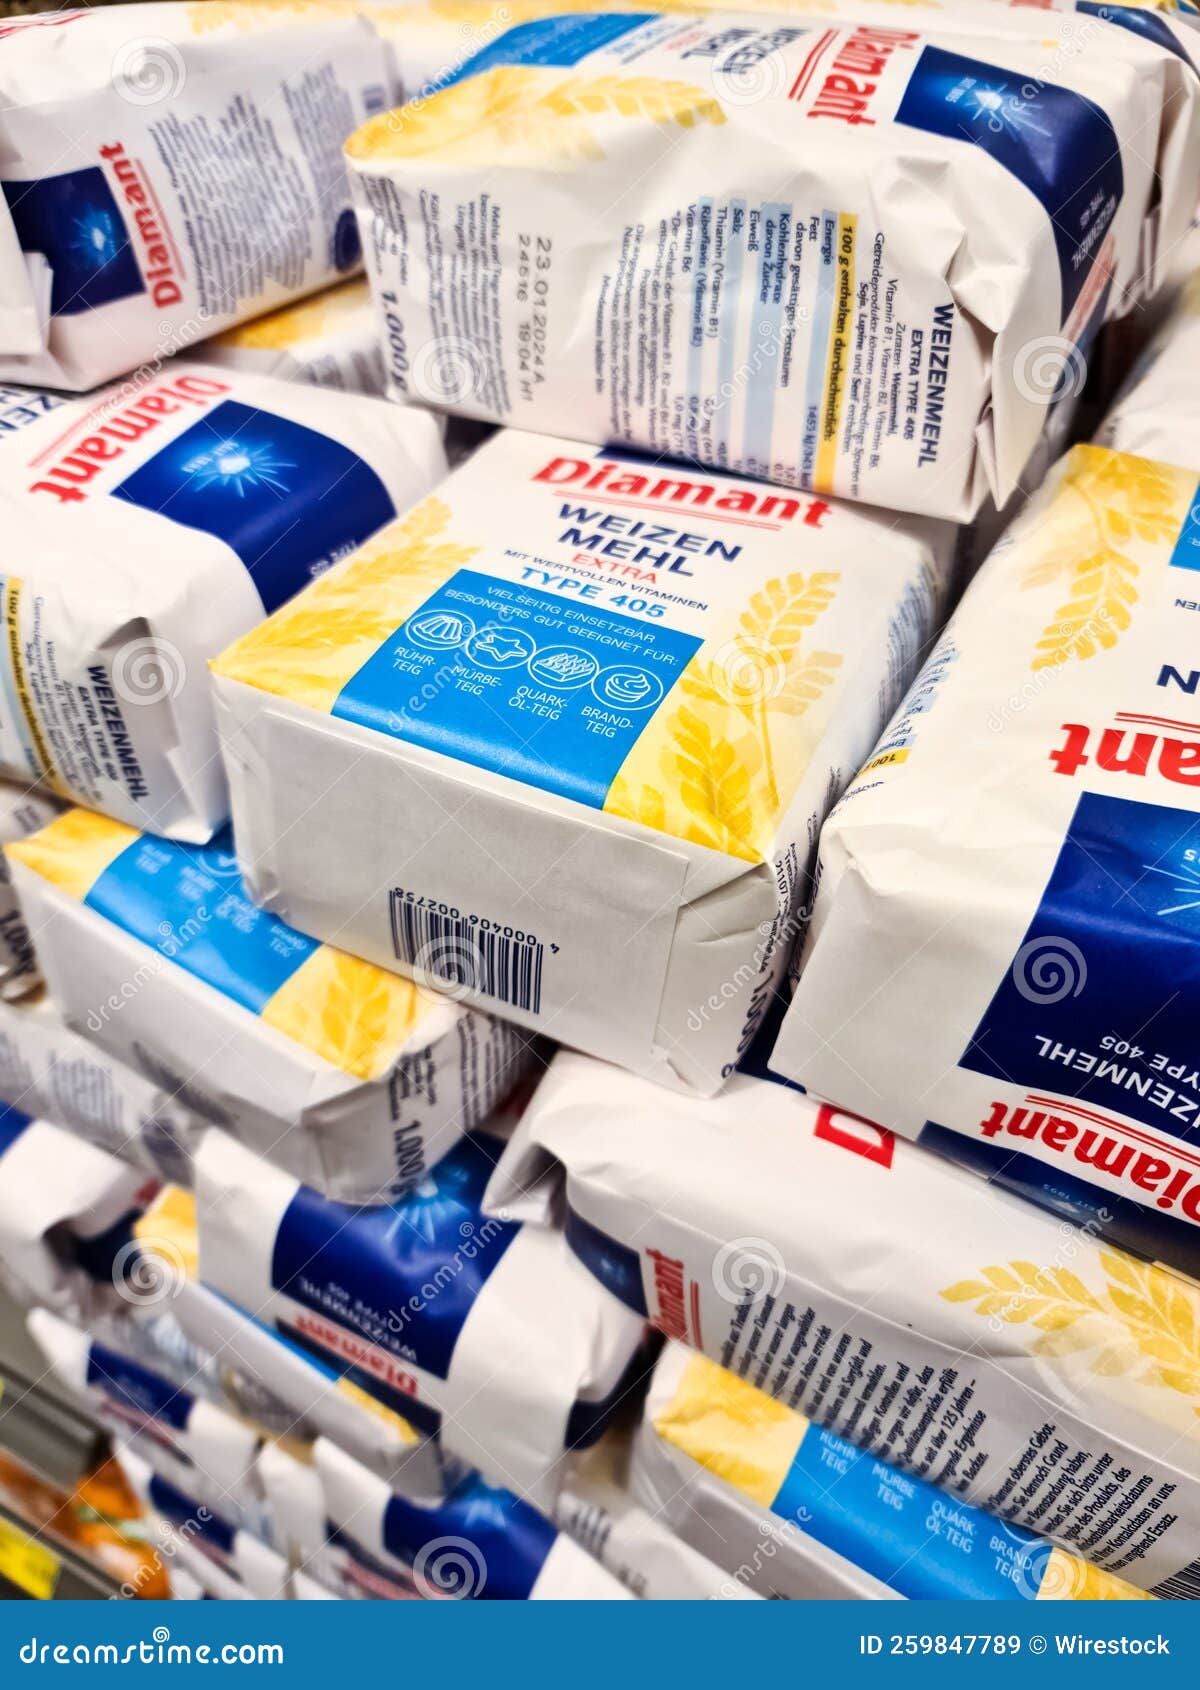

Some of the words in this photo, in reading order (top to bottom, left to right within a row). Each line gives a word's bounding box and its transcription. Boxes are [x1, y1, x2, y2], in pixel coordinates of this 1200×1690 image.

[99, 142, 182, 310] Diamant
[684, 204, 696, 252] Vitamin
[696, 204, 709, 268] Riboflavin
[713, 205, 725, 258] Thiamin
[732, 207, 743, 235] Salz
[747, 209, 760, 252] Eiweiß
[809, 216, 818, 241] Fett
[763, 219, 776, 258] davon
[793, 222, 806, 262] davon
[820, 218, 834, 265] Energie
[842, 225, 852, 253] 100
[772, 212, 788, 304] Kohlenhydrate
[837, 255, 849, 266] g
[760, 262, 773, 305] Zucker
[869, 232, 883, 333] Getreideprodukte
[836, 268, 850, 334] enthalten
[883, 278, 896, 323] Vitamin
[854, 313, 866, 350] Lupine
[854, 353, 863, 374] und
[879, 347, 889, 388] Vitamin
[907, 329, 923, 376] EXTRA
[905, 380, 918, 413] TYPE
[918, 300, 952, 469] WEIZENMEHL
[28, 374, 235, 505] Diamant
[530, 455, 836, 528] Diamant
[557, 503, 743, 562] WEIZEN
[557, 527, 694, 577] MEHL
[572, 552, 658, 585] EXTRA
[504, 549, 528, 562] MIT
[529, 555, 628, 588] WERTVOLLEN
[630, 582, 708, 611] VITAMINEN
[518, 566, 598, 600] TYPE
[609, 594, 666, 619] 405
[444, 588, 533, 622] BESONDERS
[533, 614, 565, 632] GUT
[567, 625, 642, 654] GEEIGNET
[642, 645, 679, 667] FÜR:
[486, 586, 563, 617] VIELSEITIG
[564, 611, 656, 644] EINSETZBAR
[392, 658, 423, 677] TEIG
[393, 645, 438, 668] RÜHR-
[453, 664, 504, 688] MÜRBE-
[454, 679, 486, 697] TEIG
[508, 695, 562, 721] ÖL-TEIG
[515, 684, 570, 709] QUARK-
[86, 662, 149, 803] WEIZENMEHL
[580, 704, 635, 731] BRAND-
[584, 721, 617, 739] TEIG
[395, 887, 460, 920] 002758
[468, 915, 538, 947] 000406
[1098, 1033, 1144, 1062] 405
[809, 1323, 830, 1356] erreicht
[831, 1332, 852, 1364] unseren
[853, 1337, 873, 1358] und
[839, 1353, 868, 1388] Sorgfalt
[856, 1359, 887, 1401] vermahlen.
[913, 1362, 935, 1385] dass
[933, 1365, 961, 1396] erfüllt
[871, 1378, 901, 1417] Kontrollen
[889, 1360, 910, 1382] und
[900, 1380, 927, 1409] dafür,
[947, 1383, 977, 1417] Jahren
[884, 1417, 909, 1446] sorgen
[939, 1410, 959, 1430] 125
[952, 1408, 990, 1453] Ergebnisse
[919, 1445, 938, 1463] seit
[928, 1427, 948, 1449] über
[959, 1448, 988, 1480] Backen.
[988, 1475, 1015, 1508] Diamant
[1009, 1444, 1039, 1481] oberstes
[1028, 1418, 1056, 1451] Gebot.
[1019, 1461, 1051, 1499] dennoch
[1040, 1436, 1067, 1468] Grund
[1073, 1466, 1099, 1494] bitte
[1091, 1451, 1113, 1476] unter
[1110, 1462, 1131, 1483] des
[1027, 1469, 1071, 1522] Beanstandung
[1062, 1444, 1091, 1478] haben,
[1063, 1484, 1085, 1507] sich
[1082, 1475, 1122, 1518] Produkts,
[1055, 1498, 1074, 1518] Sie
[1074, 1507, 1093, 1527] des
[1105, 1503, 1154, 1550] Kontaktdaten
[1154, 1478, 1177, 1501] uns.
[1120, 1531, 1158, 1565] umgehend
[1147, 1509, 1178, 1537] Ersatz.
[993, 1557, 1022, 1585] TEIG
